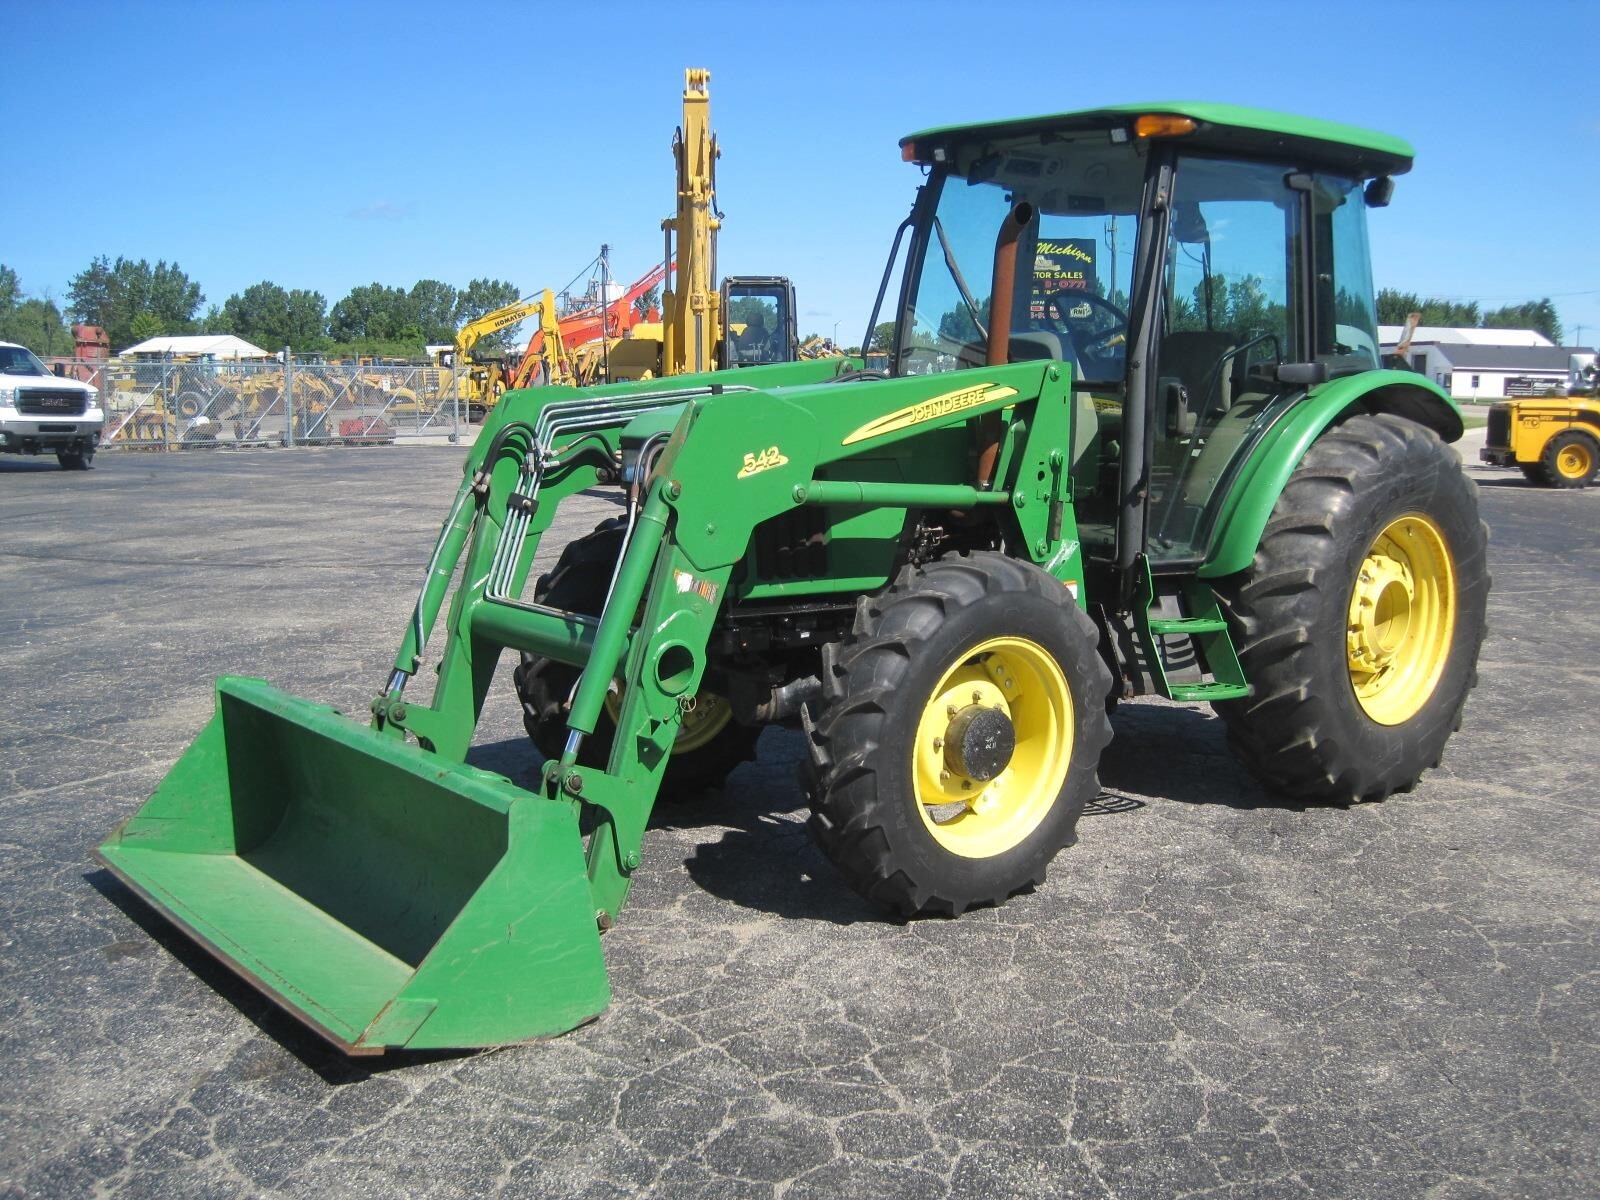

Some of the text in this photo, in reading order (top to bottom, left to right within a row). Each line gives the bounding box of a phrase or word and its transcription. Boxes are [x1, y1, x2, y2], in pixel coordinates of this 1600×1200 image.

[1036, 242, 1092, 263] Michigan
[1053, 271, 1084, 279] SALES
[495, 311, 526, 327] KOMATSU
[909, 389, 985, 423] JOHN DEERE
[743, 445, 781, 473] 542
